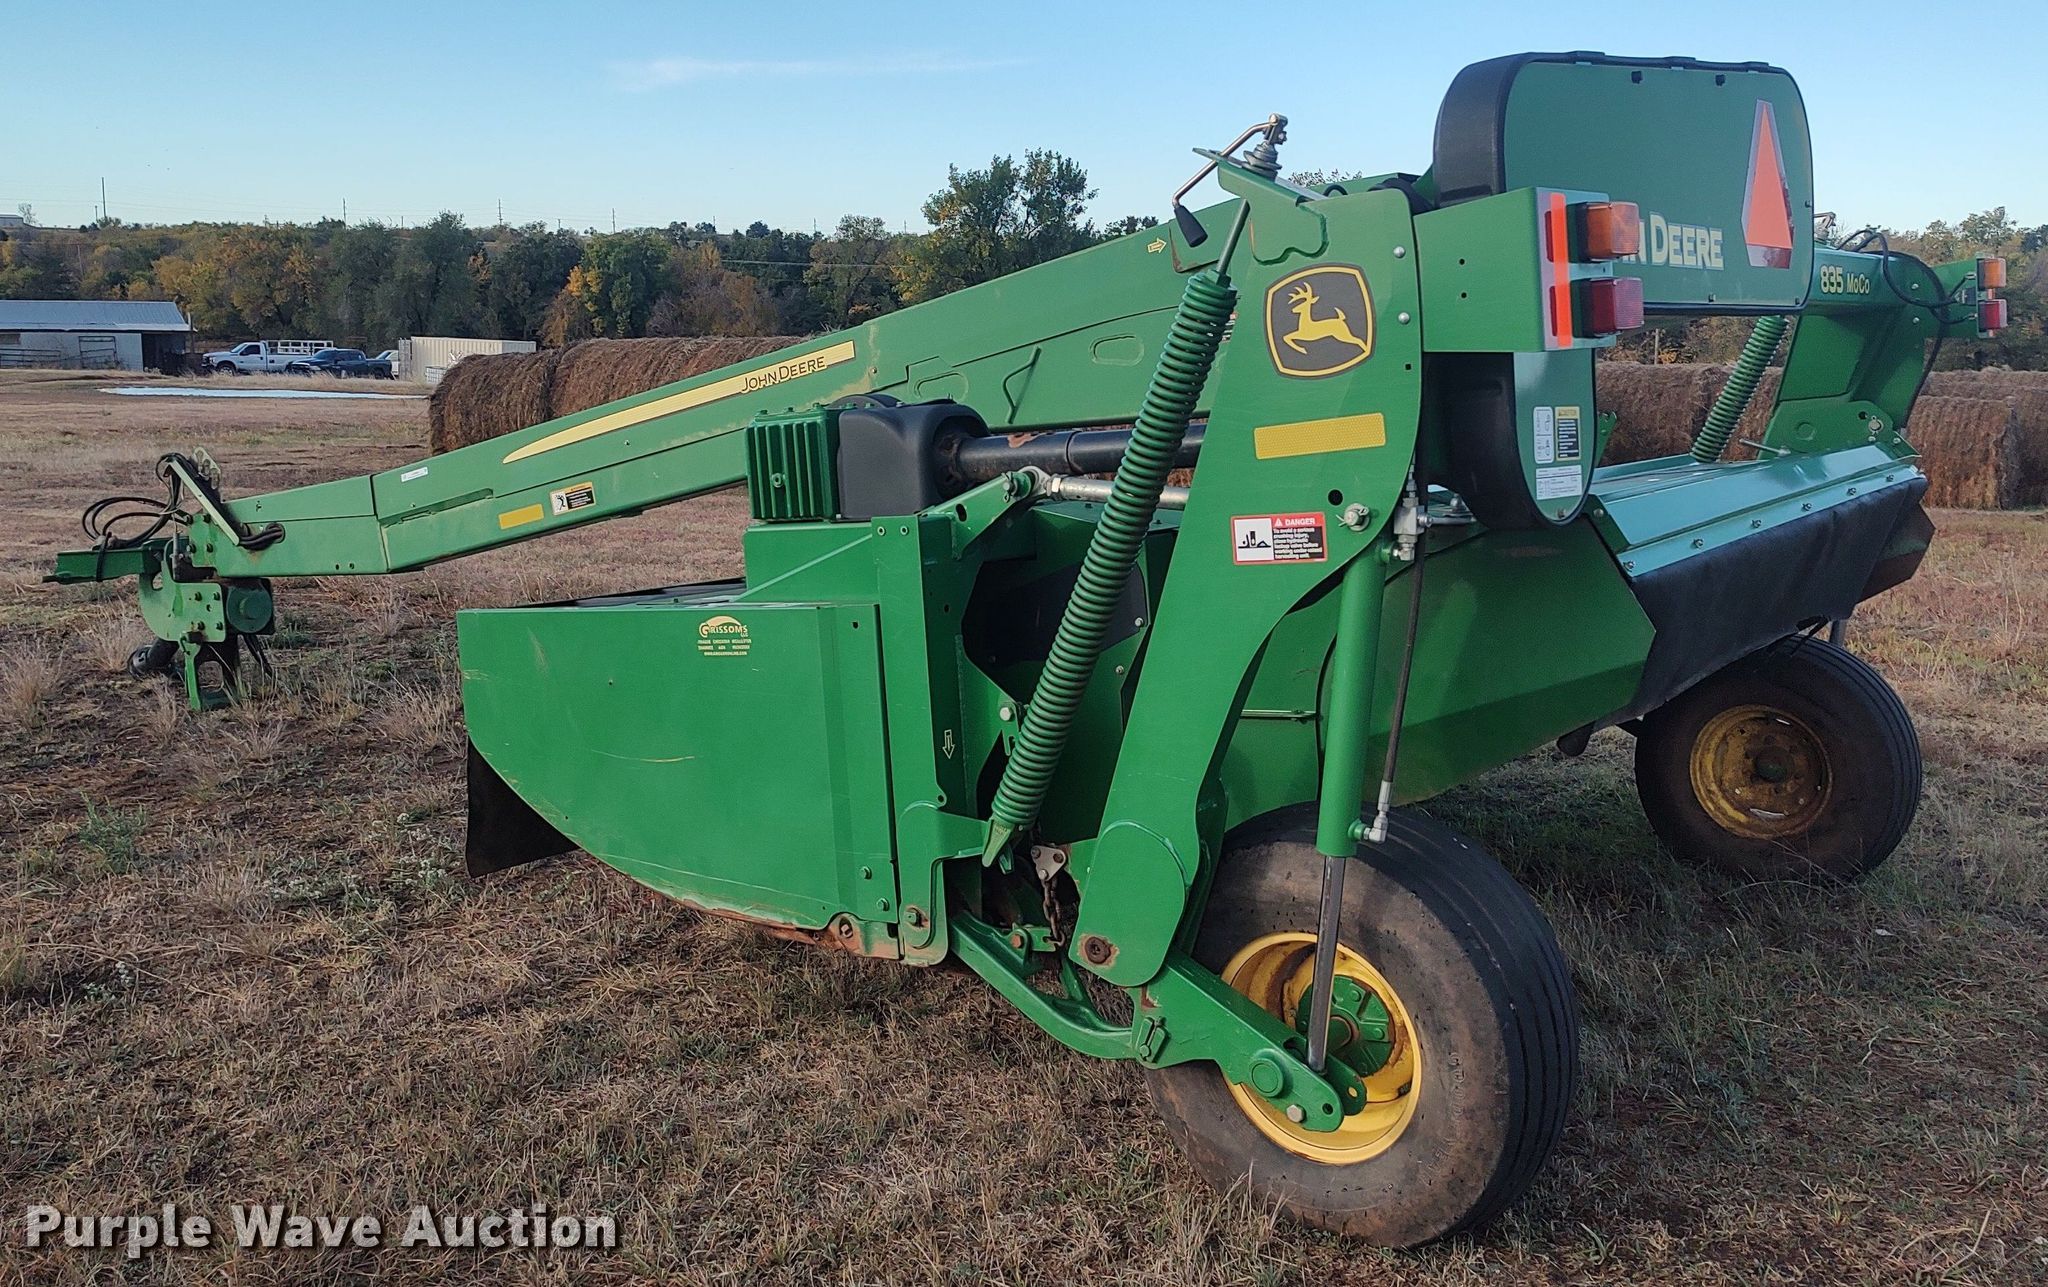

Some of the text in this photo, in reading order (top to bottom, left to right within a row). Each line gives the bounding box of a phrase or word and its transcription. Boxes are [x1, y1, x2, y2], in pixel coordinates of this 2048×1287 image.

[1650, 213, 1723, 269] DEERE
[1820, 265, 1870, 294] 835 MoCo
[741, 356, 825, 392] JOHN DEERE
[1284, 518, 1315, 526] DANGER
